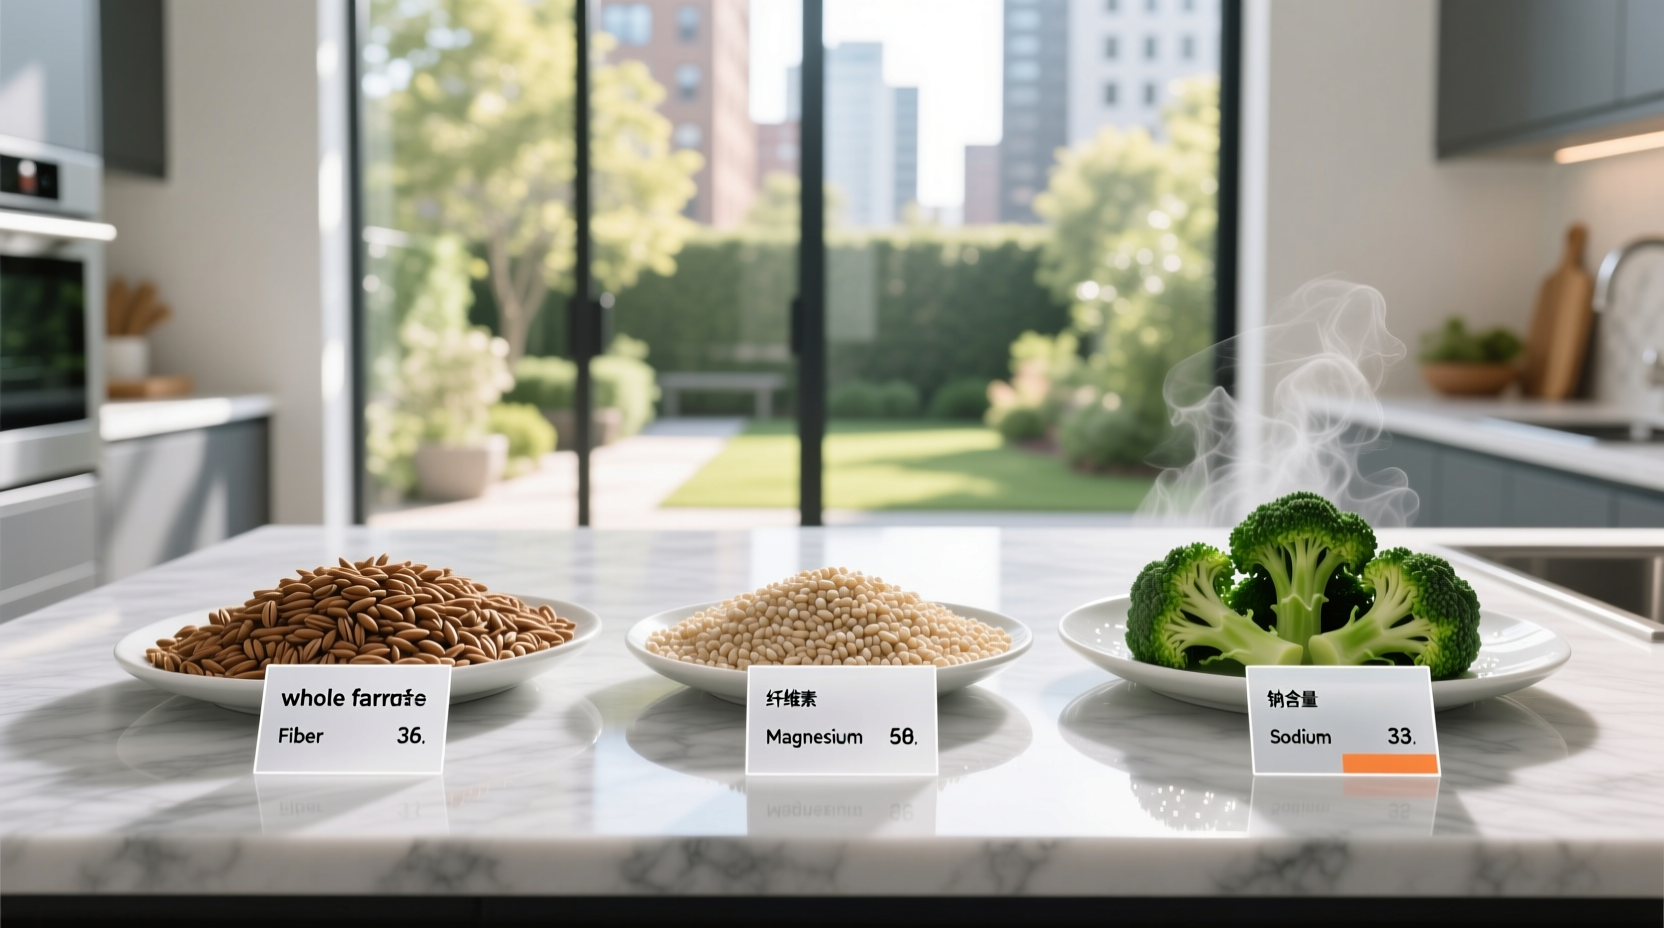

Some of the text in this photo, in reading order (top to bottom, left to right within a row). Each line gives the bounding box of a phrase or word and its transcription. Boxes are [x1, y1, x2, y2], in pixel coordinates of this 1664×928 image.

[281, 688, 345, 707] whole
[765, 688, 818, 708] 纤维素
[278, 726, 426, 745] Fiber 36.
[766, 728, 863, 749] Magnesium
[1270, 727, 1417, 746] Sodium 33.
